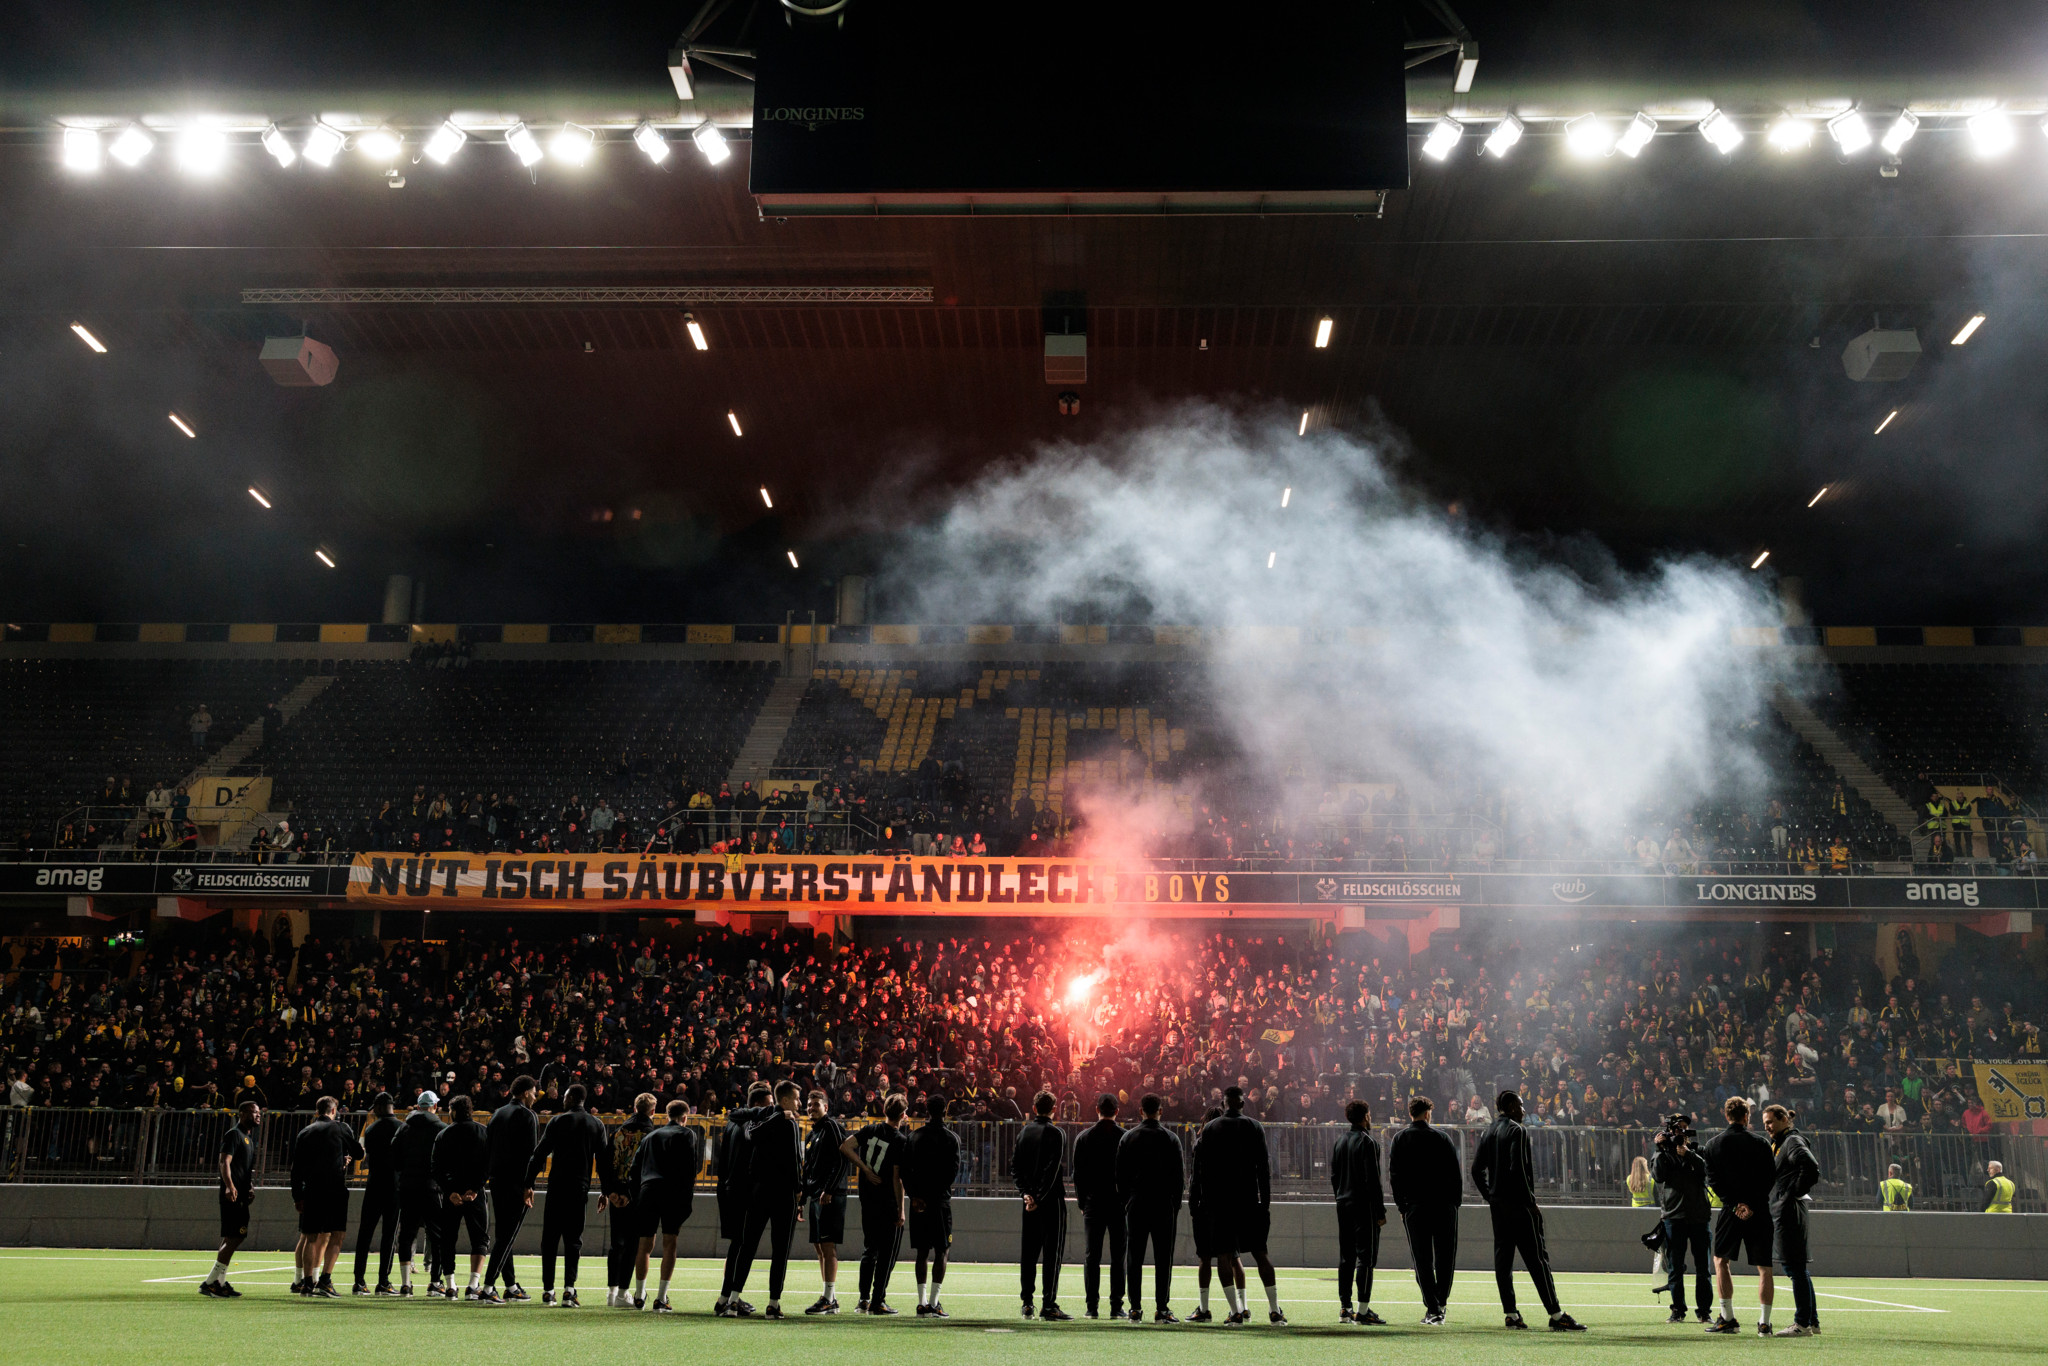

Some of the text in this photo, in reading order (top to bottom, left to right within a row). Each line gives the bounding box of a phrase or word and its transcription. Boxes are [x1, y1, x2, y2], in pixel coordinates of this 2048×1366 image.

[762, 107, 864, 121] LONGINES
[35, 867, 104, 891] amag
[198, 873, 310, 888] FELDSCHLÖSSCHEN
[368, 852, 470, 898] NÜT
[482, 859, 588, 900] ISCH
[1145, 874, 1230, 902] BOYS
[1343, 881, 1461, 896] FELDSCHLÖSSCHEN
[1552, 878, 1586, 895] ewb
[1697, 884, 1817, 901] LONGINES
[1906, 882, 1980, 906] amag
[866, 1136, 890, 1175] 17
